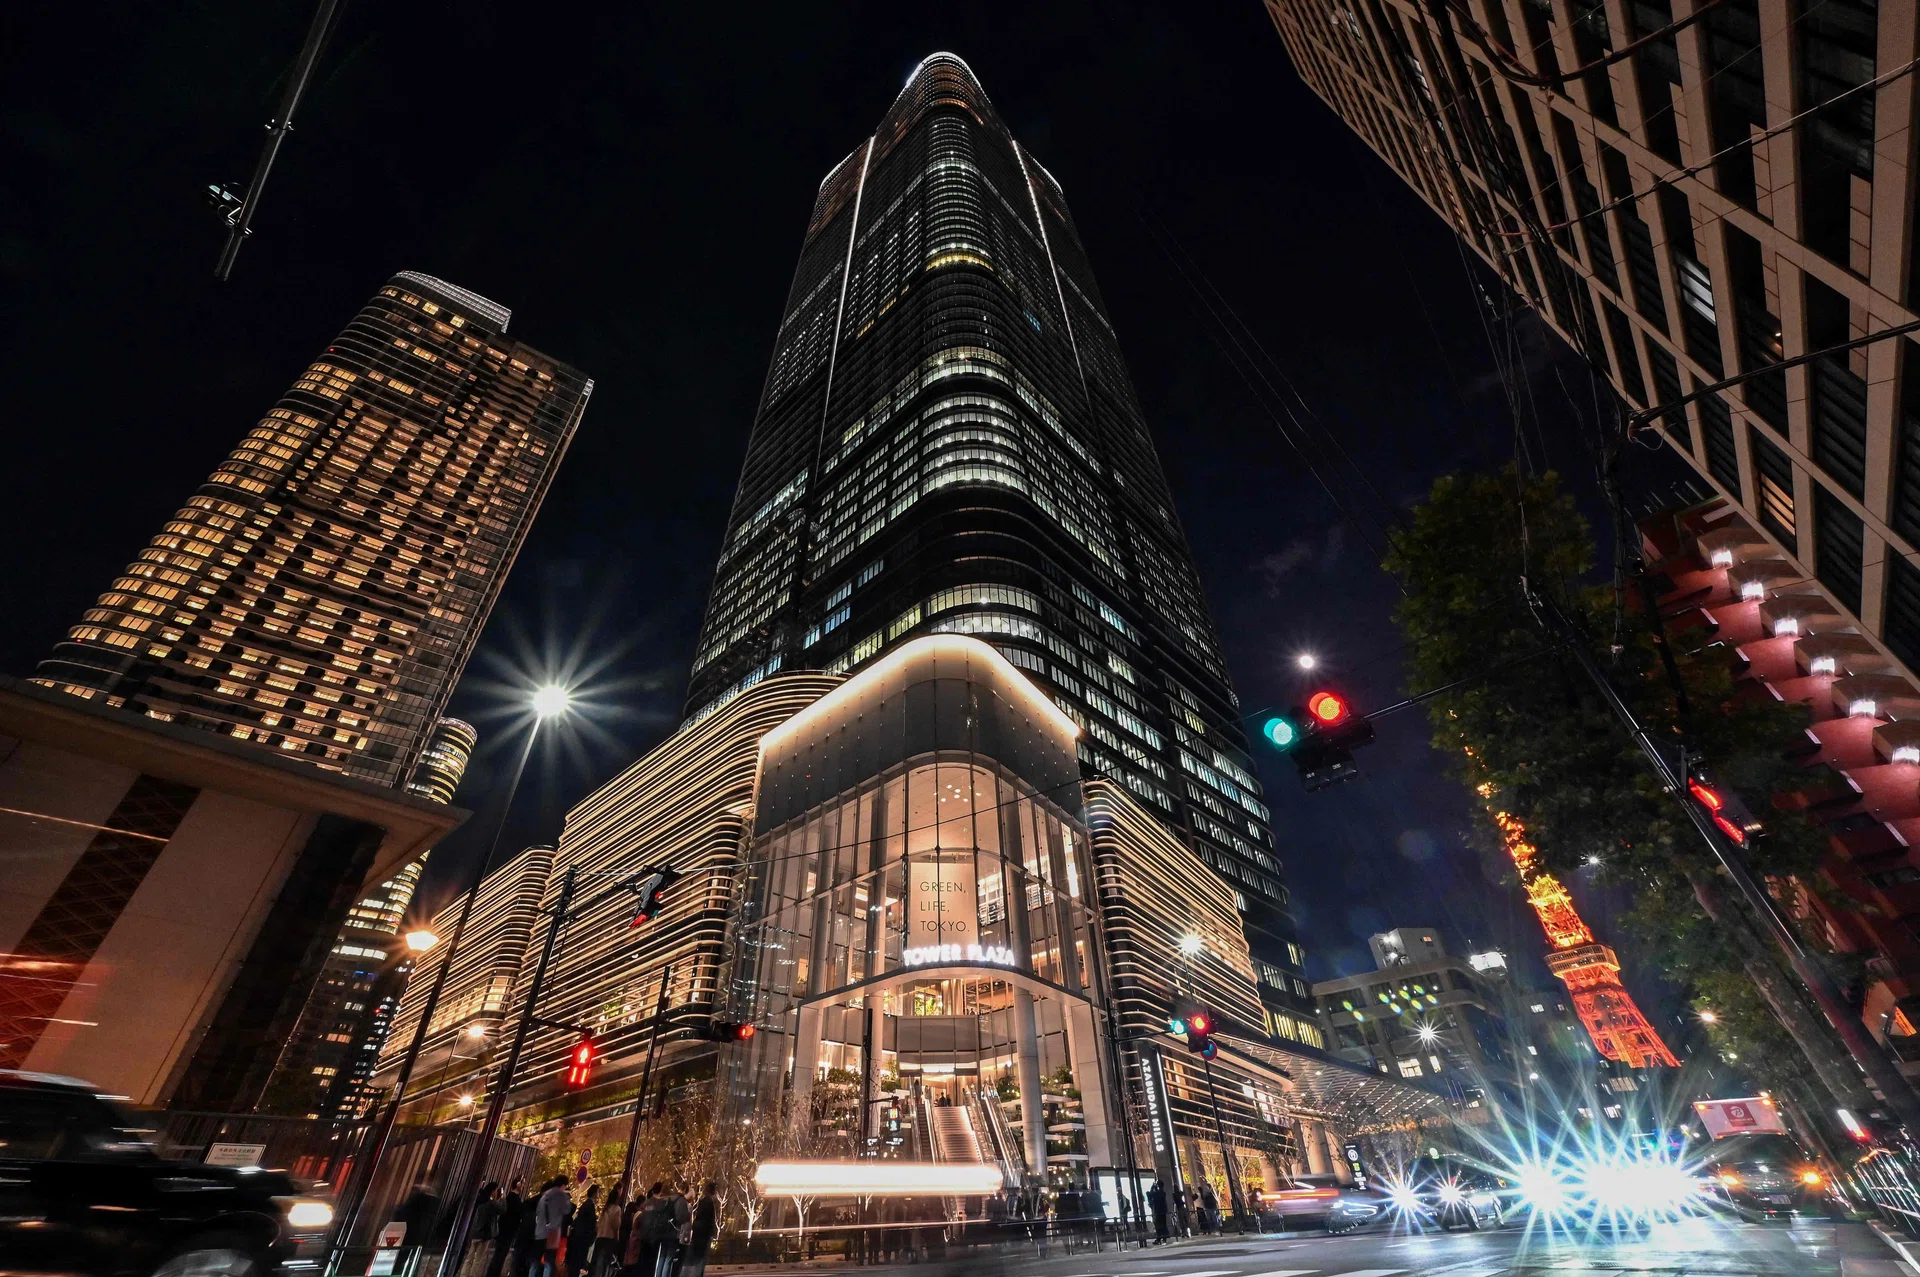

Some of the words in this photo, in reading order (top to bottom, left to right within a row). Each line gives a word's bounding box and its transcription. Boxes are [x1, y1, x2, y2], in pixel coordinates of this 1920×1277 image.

[919, 881, 967, 894] GREEN,
[919, 901, 950, 913] LIFE,
[920, 920, 970, 932] TOKYO.
[903, 944, 961, 966] TOWER
[967, 944, 1015, 966] PLAZA
[1141, 1058, 1158, 1115] AZABUDAI
[1151, 1118, 1165, 1152] HILLS
